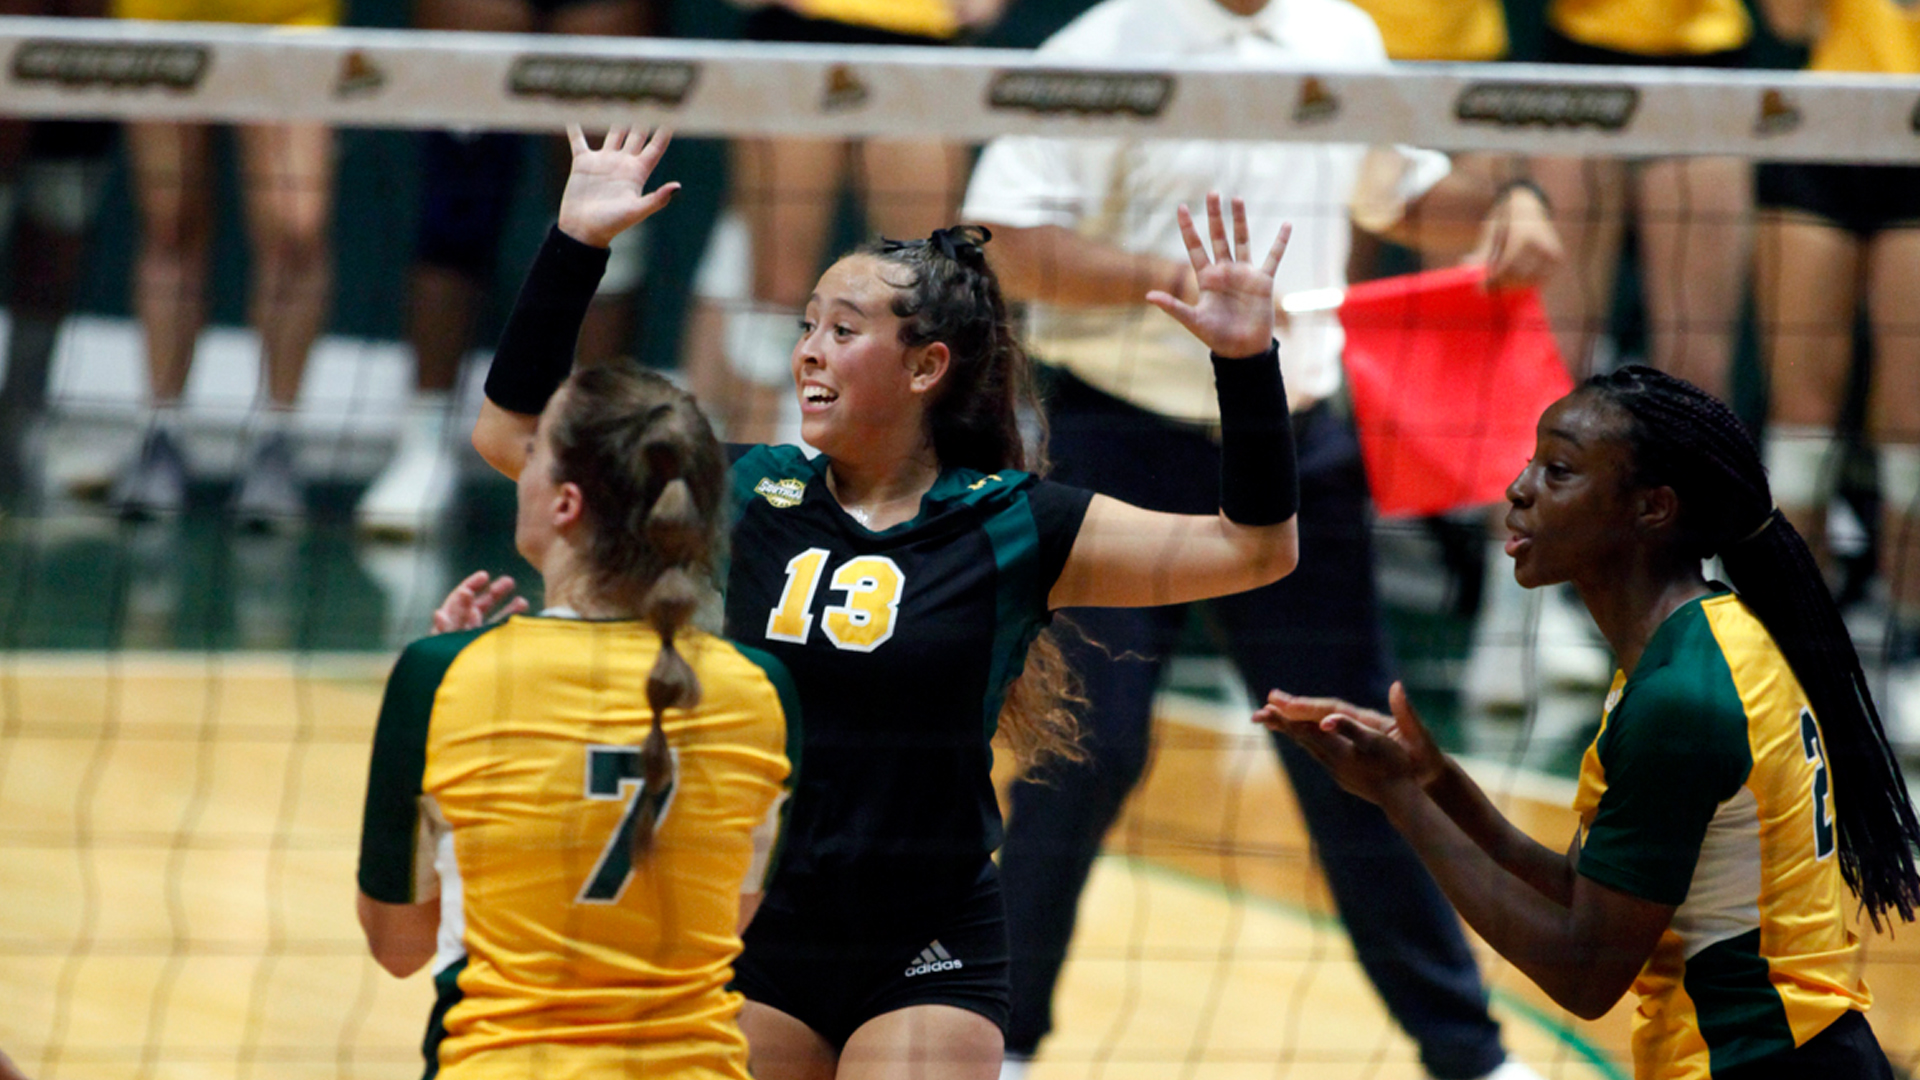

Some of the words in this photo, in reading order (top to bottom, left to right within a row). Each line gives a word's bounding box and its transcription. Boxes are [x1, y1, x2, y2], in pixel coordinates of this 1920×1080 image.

[765, 547, 906, 653] 13
[574, 744, 679, 905] 7
[1799, 705, 1836, 861] 2
[904, 959, 963, 977] adidas
